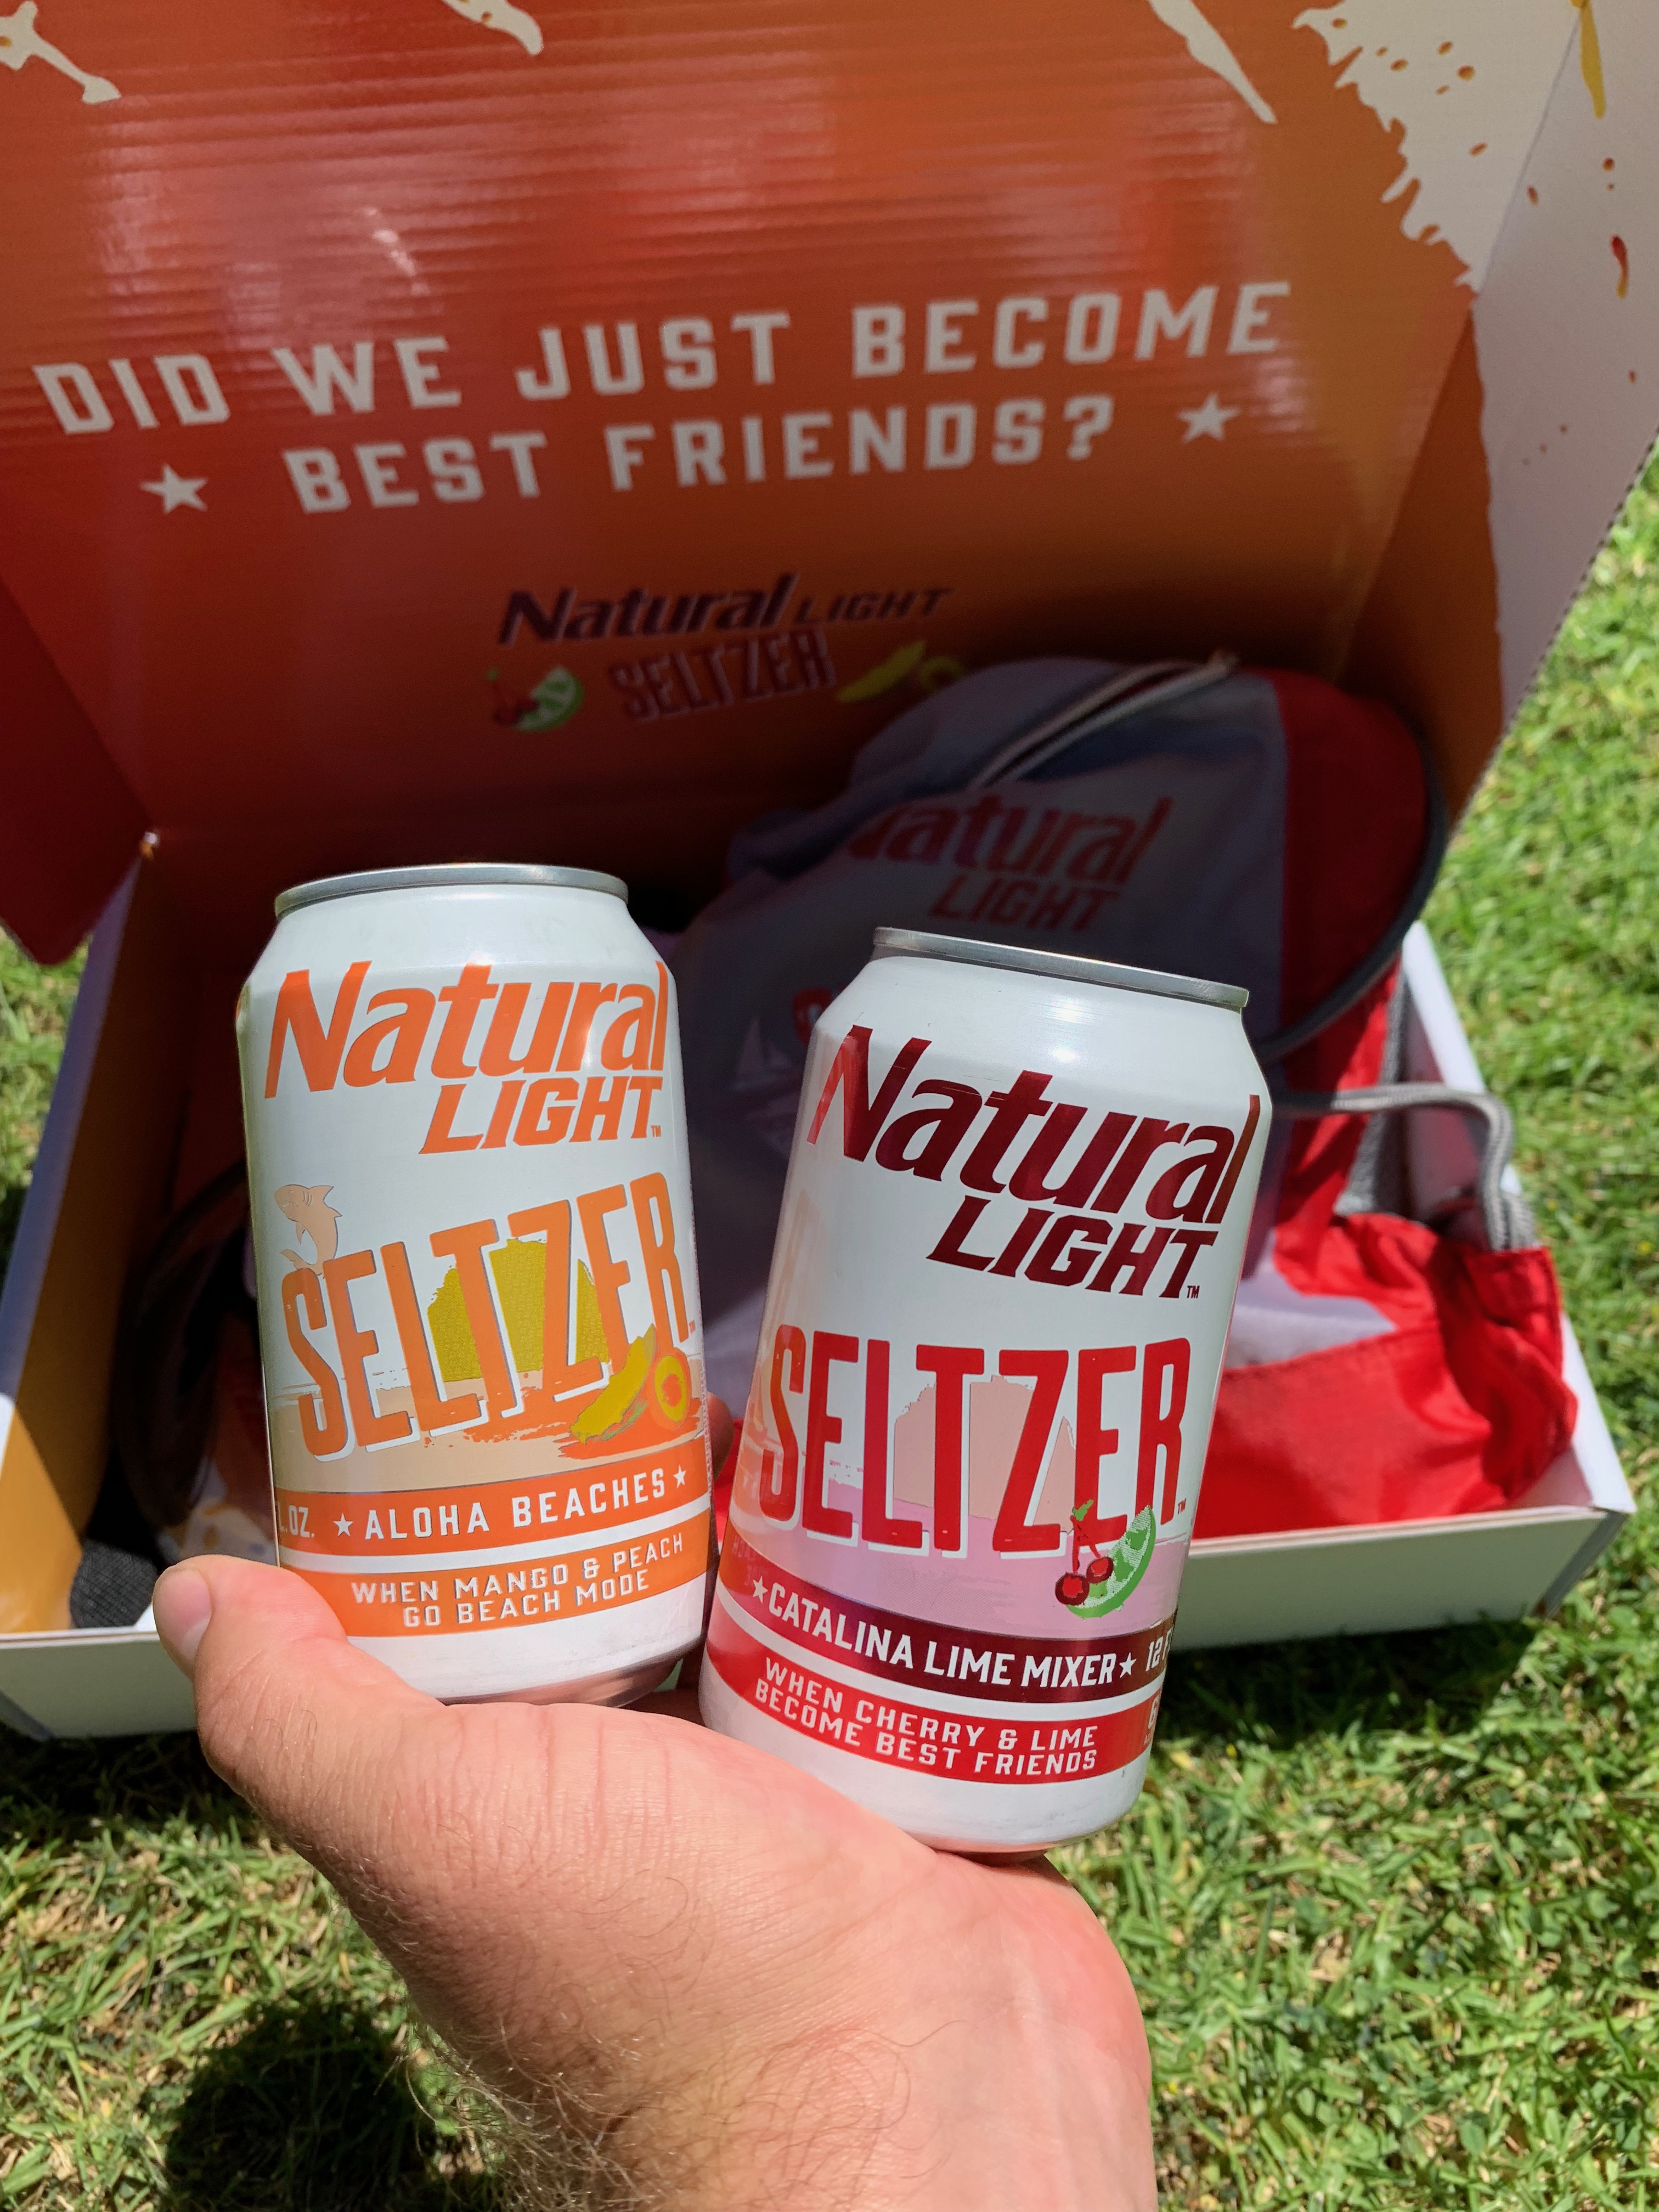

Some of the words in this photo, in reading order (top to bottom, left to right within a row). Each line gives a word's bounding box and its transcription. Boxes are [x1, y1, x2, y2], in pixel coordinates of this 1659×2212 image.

[32, 353, 230, 435] DID
[273, 337, 461, 415] WE
[516, 311, 790, 400] JUST
[851, 281, 1290, 377] BECOME
[283, 431, 546, 514] BEST
[604, 394, 1114, 491] FRIENDS?
[499, 573, 798, 647] Natural
[797, 587, 954, 624] LIGHT
[609, 627, 837, 722] SELTZER
[930, 877, 1120, 932] LIGHT
[264, 961, 668, 1098] Natural
[418, 1076, 663, 1154] LIGHT
[806, 1024, 1260, 1223] Natural
[926, 1195, 1219, 1299] LIGHT
[281, 1172, 689, 1463] SELTZER
[758, 1325, 1190, 1559] SELTZER
[288, 1504, 315, 1538] OZ.
[364, 1502, 490, 1540] ALOHA
[512, 1468, 665, 1528] BEACHES
[351, 1580, 439, 1604] WHEN
[454, 1564, 568, 1599] MANGO
[582, 1558, 599, 1578] &
[613, 1533, 684, 1573] PEACH
[403, 1607, 440, 1627] GO
[456, 1590, 560, 1624] BEACH
[576, 1568, 650, 1607] MODE
[769, 1582, 913, 1670] CATALINA
[925, 1641, 1016, 1686] LIME
[1022, 1653, 1115, 1688] MIXER
[1146, 1636, 1164, 1672] 12
[755, 1677, 861, 1747] BECOME
[876, 1734, 961, 1770] BEST
[974, 1750, 1097, 1775] FRIENDS
[765, 1657, 844, 1713] WHEN
[856, 1701, 985, 1747] CHERRY
[998, 1729, 1017, 1750] &
[1031, 1725, 1098, 1751] LIME
